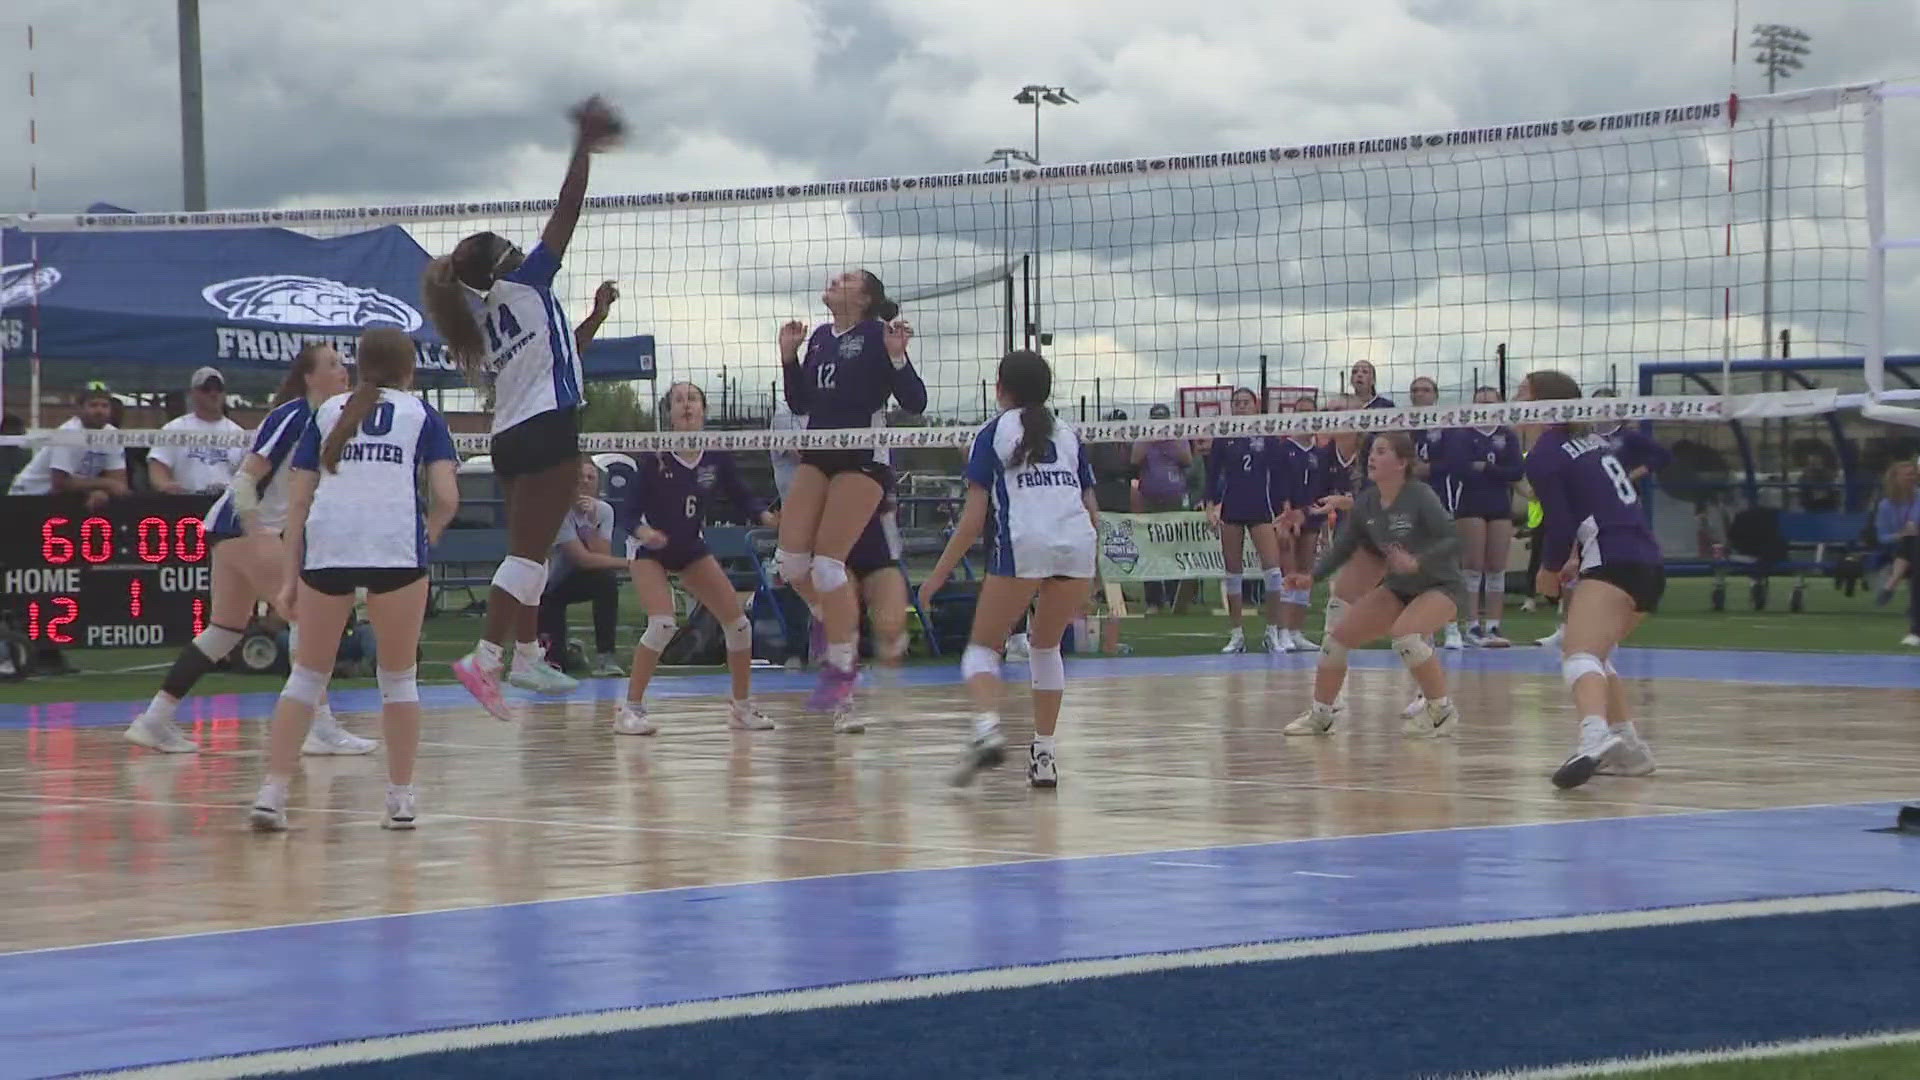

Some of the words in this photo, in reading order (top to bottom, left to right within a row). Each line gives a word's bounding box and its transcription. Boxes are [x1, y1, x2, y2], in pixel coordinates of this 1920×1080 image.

[1600, 111, 1660, 131] FRONTIER
[1664, 103, 1720, 123] FALCONS
[1447, 127, 1502, 146] FRONTIER
[1506, 122, 1558, 140] FALCONS
[1303, 141, 1355, 159] FRONTIER
[1359, 136, 1408, 154] FALCONS
[1040, 163, 1087, 179] FRONTIER
[1090, 160, 1134, 176] FALCONS
[1168, 154, 1218, 170] FRONTIER
[1221, 149, 1266, 167] FALCONS
[803, 182, 846, 196] FRONTIER
[849, 178, 888, 193] FALCONS
[919, 174, 964, 189] FRONTIER
[967, 170, 1008, 185] FALCONS
[585, 195, 624, 209] FRONTIER
[627, 193, 663, 207] FALCONS
[692, 188, 733, 202] FRONTIER
[735, 186, 773, 200] FALCONS
[323, 207, 356, 220] FALCONS
[381, 205, 419, 217] FRONTIER
[421, 203, 456, 216] FALCONS
[481, 201, 521, 214] FRONTIER
[486, 303, 522, 352] 14
[817, 363, 836, 389] 12
[354, 401, 395, 436] 0
[343, 443, 403, 464] ONTIER
[1242, 453, 1253, 472] 2
[1303, 468, 1310, 485] 1
[1600, 455, 1637, 504] 8
[685, 495, 697, 518] 6
[41, 516, 208, 563] 60:00
[1148, 520, 1211, 544] FRONTIER
[1175, 551, 1225, 571] STADIU
[5, 568, 81, 594] HOME
[159, 567, 210, 592] GUE
[129, 578, 143, 619] 1
[28, 596, 79, 643] 12
[87, 625, 164, 646] PERIOD
